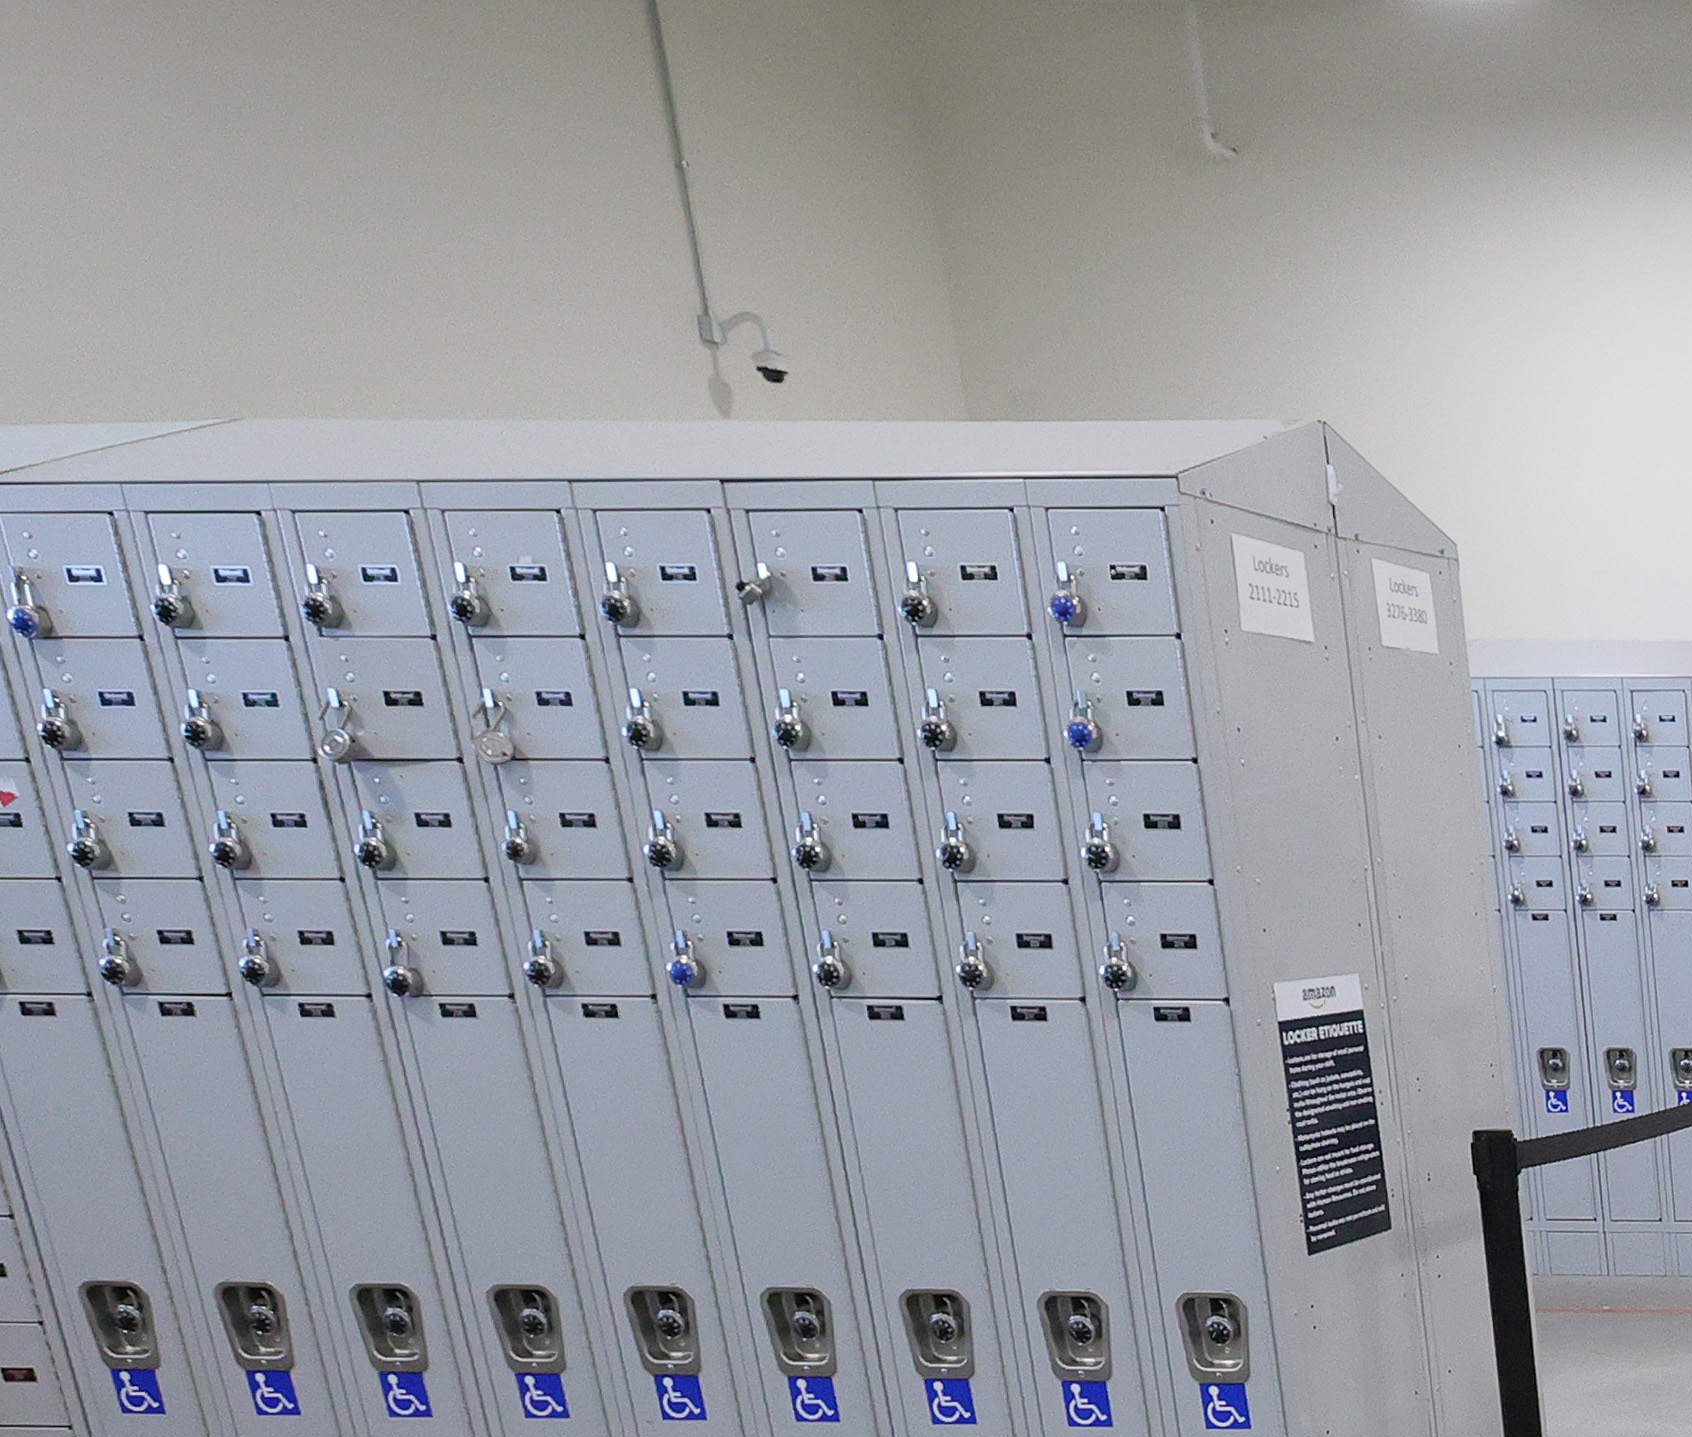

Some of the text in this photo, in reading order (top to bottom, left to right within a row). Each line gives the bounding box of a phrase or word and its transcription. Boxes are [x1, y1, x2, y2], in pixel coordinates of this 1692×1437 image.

[1252, 556, 1290, 578] Lockers
[1248, 583, 1300, 609] 2111-2215
[1389, 577, 1419, 597] Lockers
[1302, 986, 1336, 1001] amazon
[1282, 1020, 1364, 1046] LOCKER ETIQUETTE
